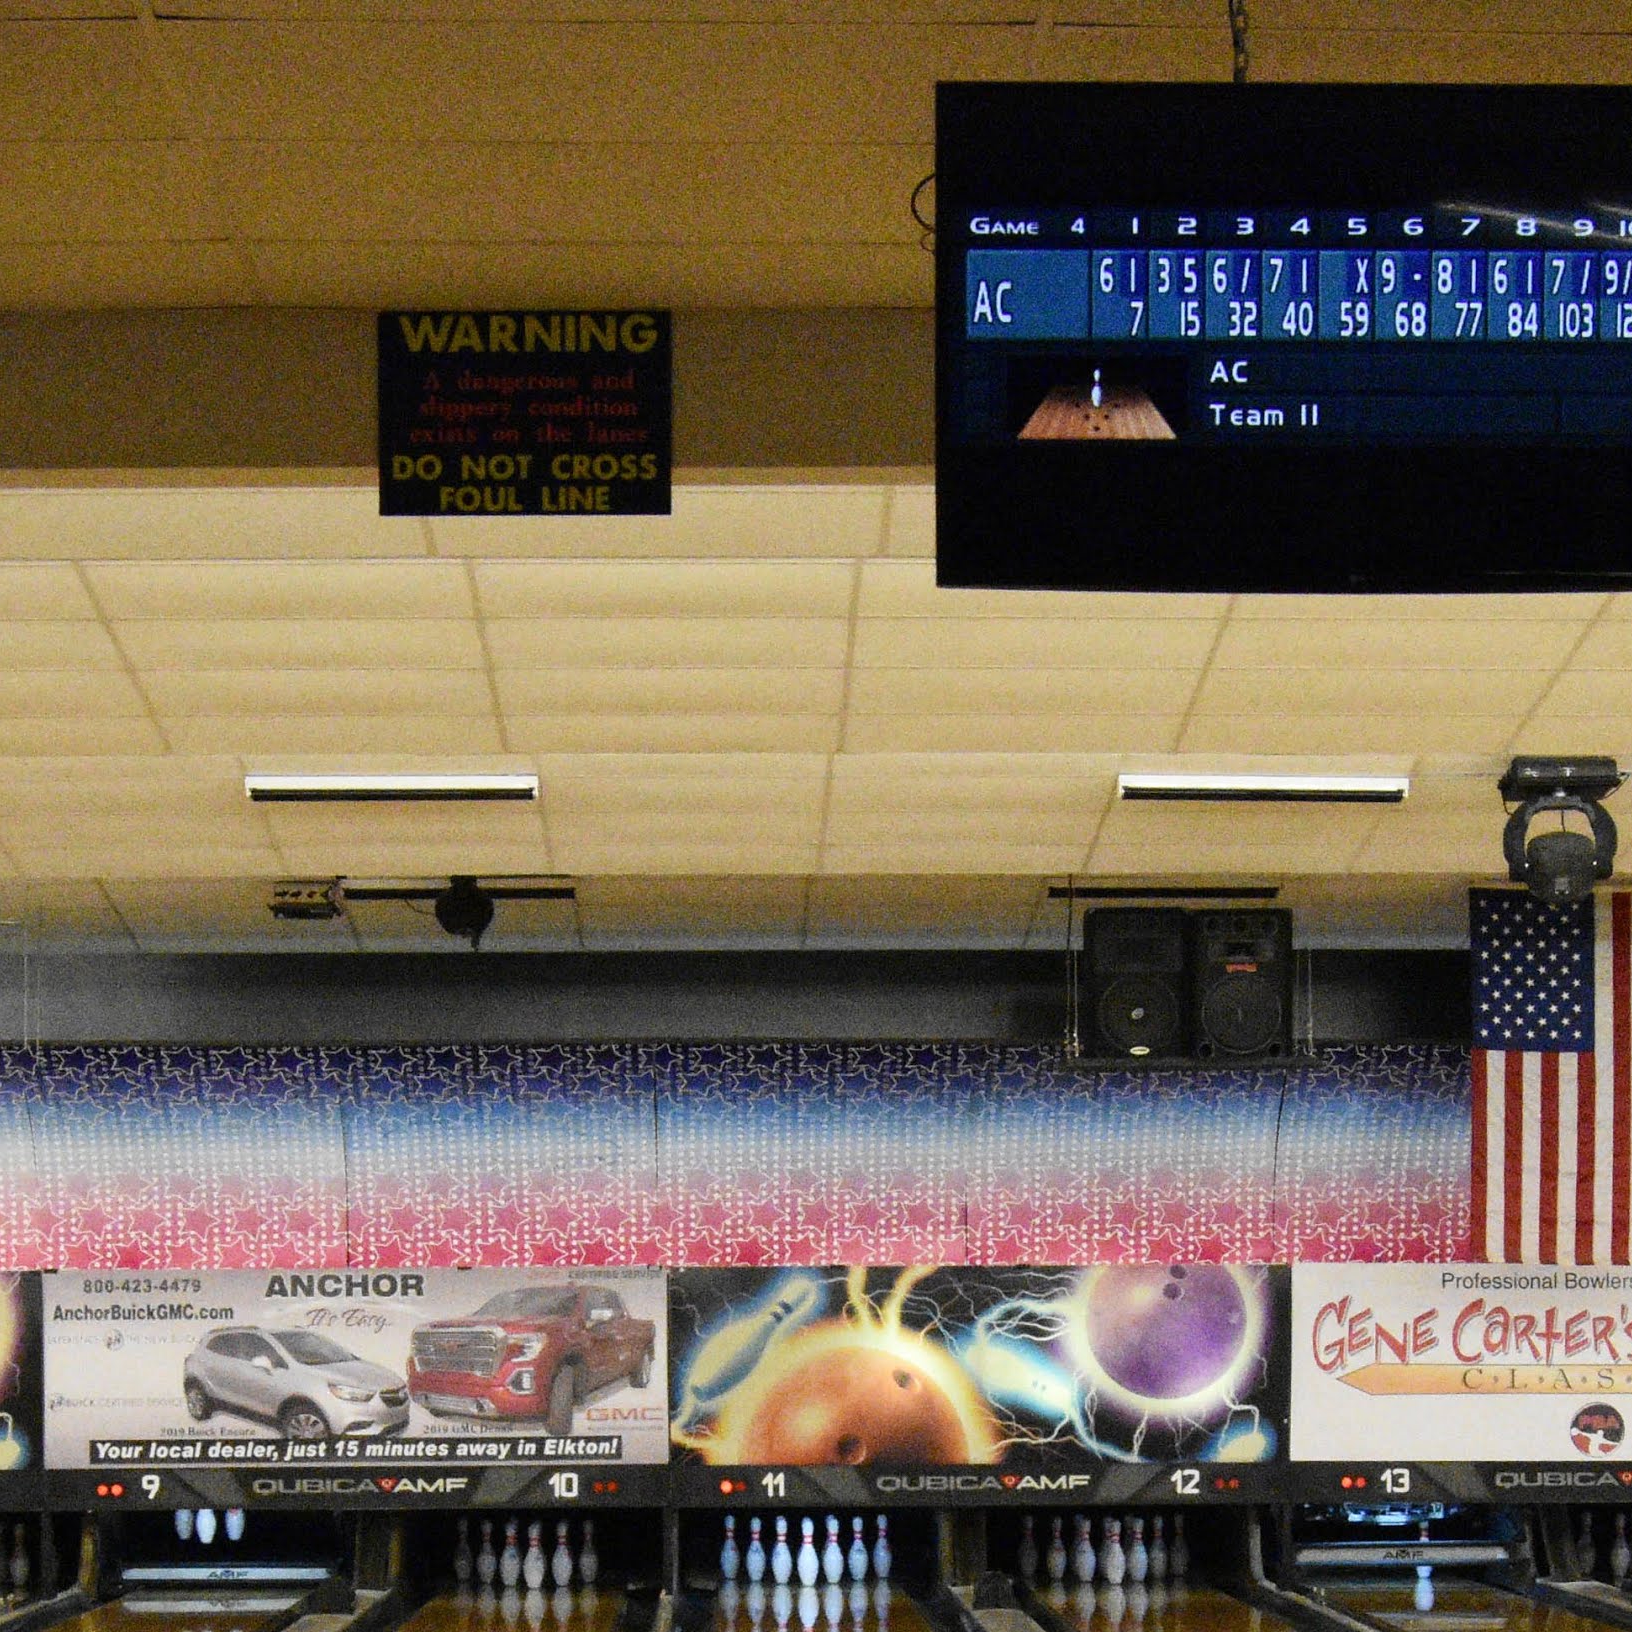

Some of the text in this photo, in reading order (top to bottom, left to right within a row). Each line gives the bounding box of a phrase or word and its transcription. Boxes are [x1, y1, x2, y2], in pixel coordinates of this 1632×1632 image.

[974, 282, 1011, 322] AC
[400, 314, 657, 353] WARNING
[1210, 360, 1247, 383] AC
[1209, 403, 1284, 426] Team
[392, 454, 657, 480] DO NOT CROSS
[440, 486, 609, 512] FOUL LINE
[82, 1278, 202, 1295] 800-423-4479
[266, 1274, 423, 1297] ANCHOR
[1442, 1272, 1558, 1290] Professional
[53, 1304, 233, 1323] AnchorBuickGMC.com
[1312, 1295, 1439, 1373] GENE
[586, 1407, 664, 1421] GMC
[96, 1438, 617, 1461] Your local dealer, just 15 minutes away in Elkton!
[140, 1474, 161, 1500] 9
[394, 1478, 468, 1493] AMF
[547, 1471, 579, 1497] 10
[761, 1472, 786, 1498] 11
[1170, 1469, 1200, 1495] 12
[1380, 1467, 1411, 1494] 13
